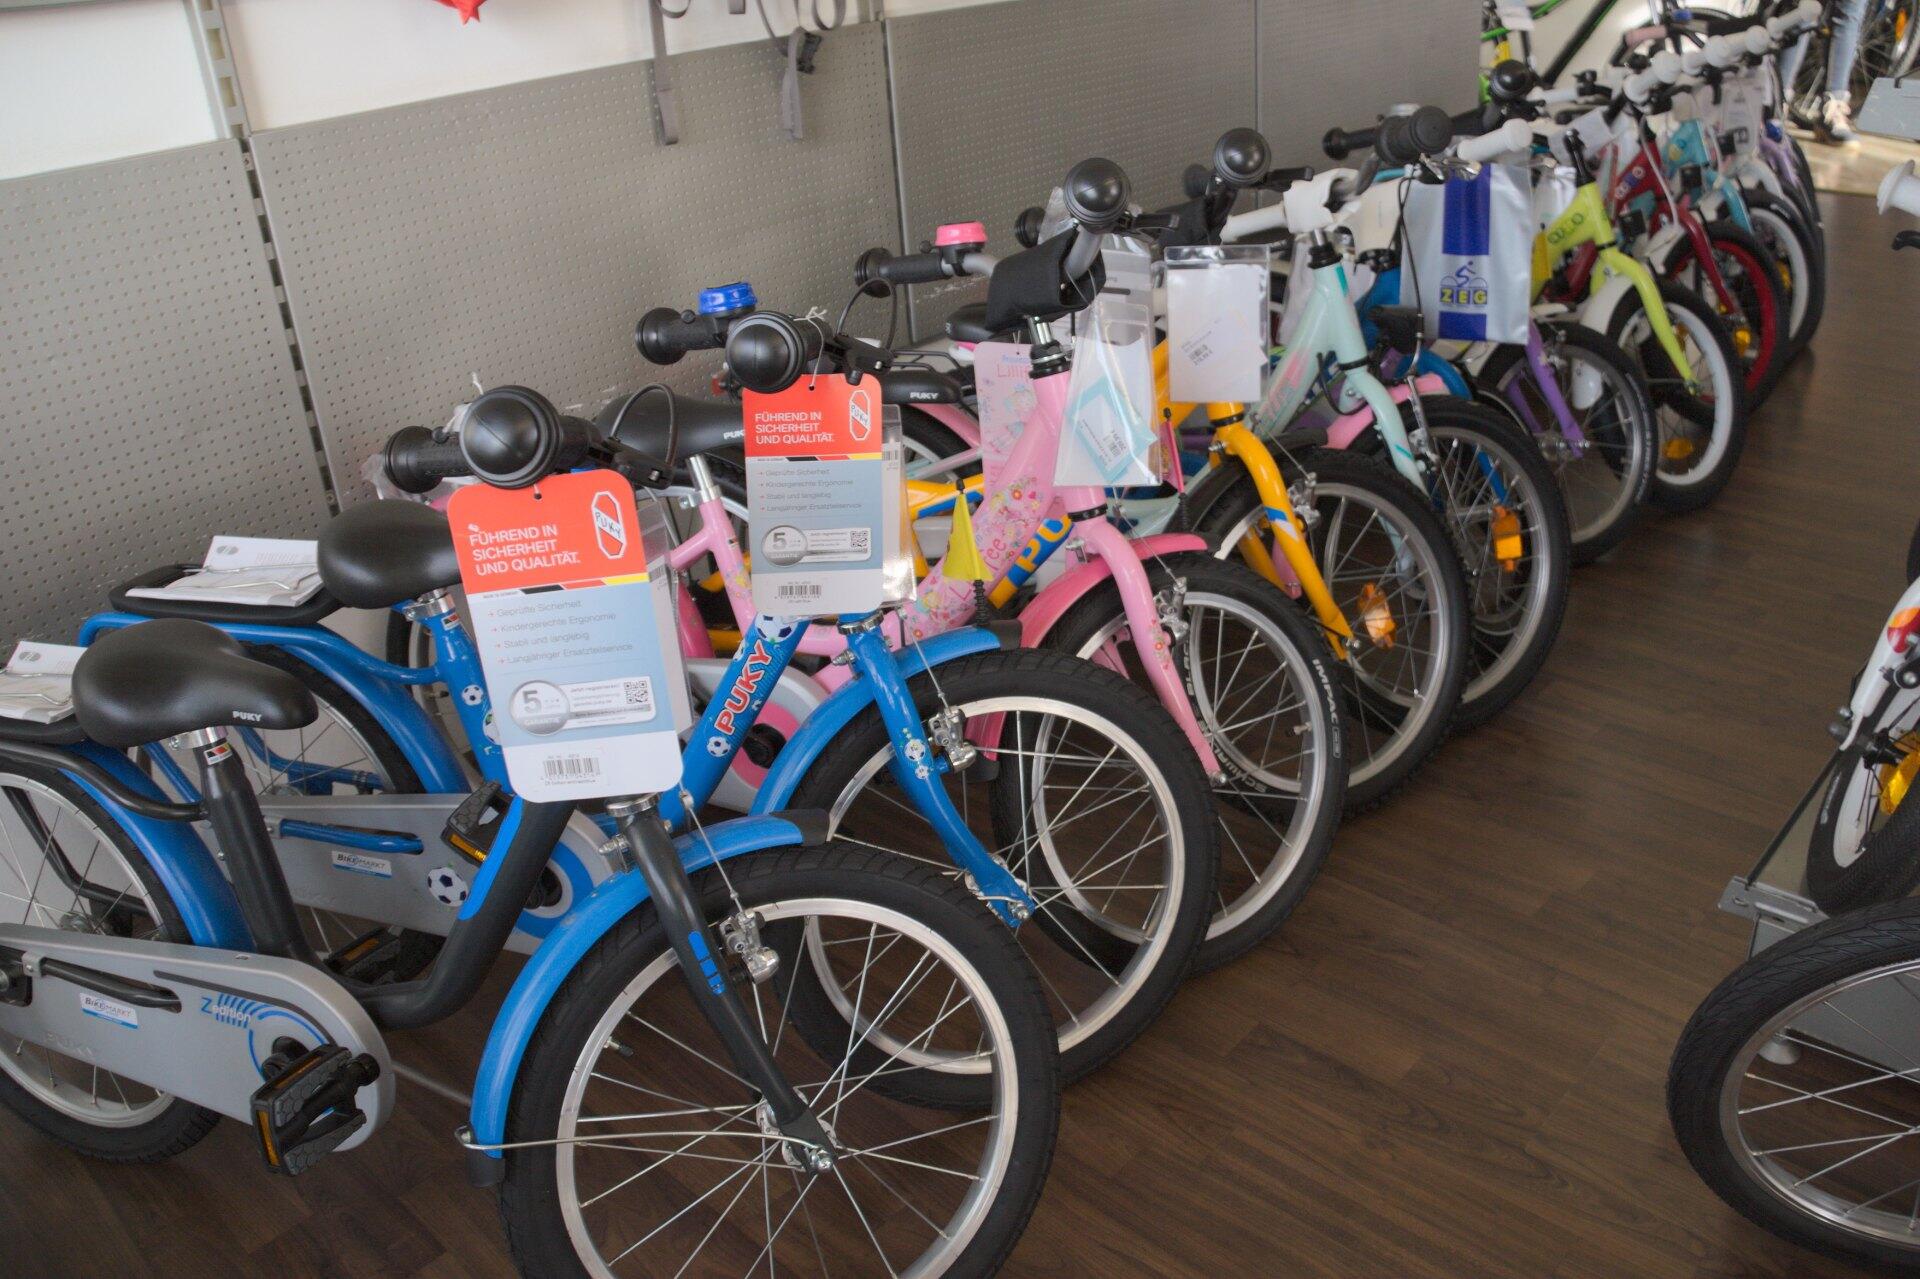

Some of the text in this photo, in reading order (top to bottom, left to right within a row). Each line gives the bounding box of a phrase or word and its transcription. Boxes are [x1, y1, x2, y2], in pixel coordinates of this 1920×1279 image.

[1440, 287, 1487, 305] ZEG
[910, 391, 938, 400] PUKY
[755, 411, 821, 422] FÜHREND IN
[723, 430, 745, 440] PUK
[755, 423, 820, 434] SICHERHEIT
[756, 435, 780, 445] UND
[469, 524, 558, 546] FÜHREND IN
[772, 532, 787, 550] 5
[1015, 514, 1073, 573] PU
[472, 539, 558, 561] SICHERHEIT
[475, 560, 509, 576] UND
[714, 639, 772, 736] PUKY
[1312, 658, 1339, 725] IMPAC
[522, 690, 541, 713] 5
[232, 710, 262, 721] PUKY
[201, 997, 252, 1022] Z edition
